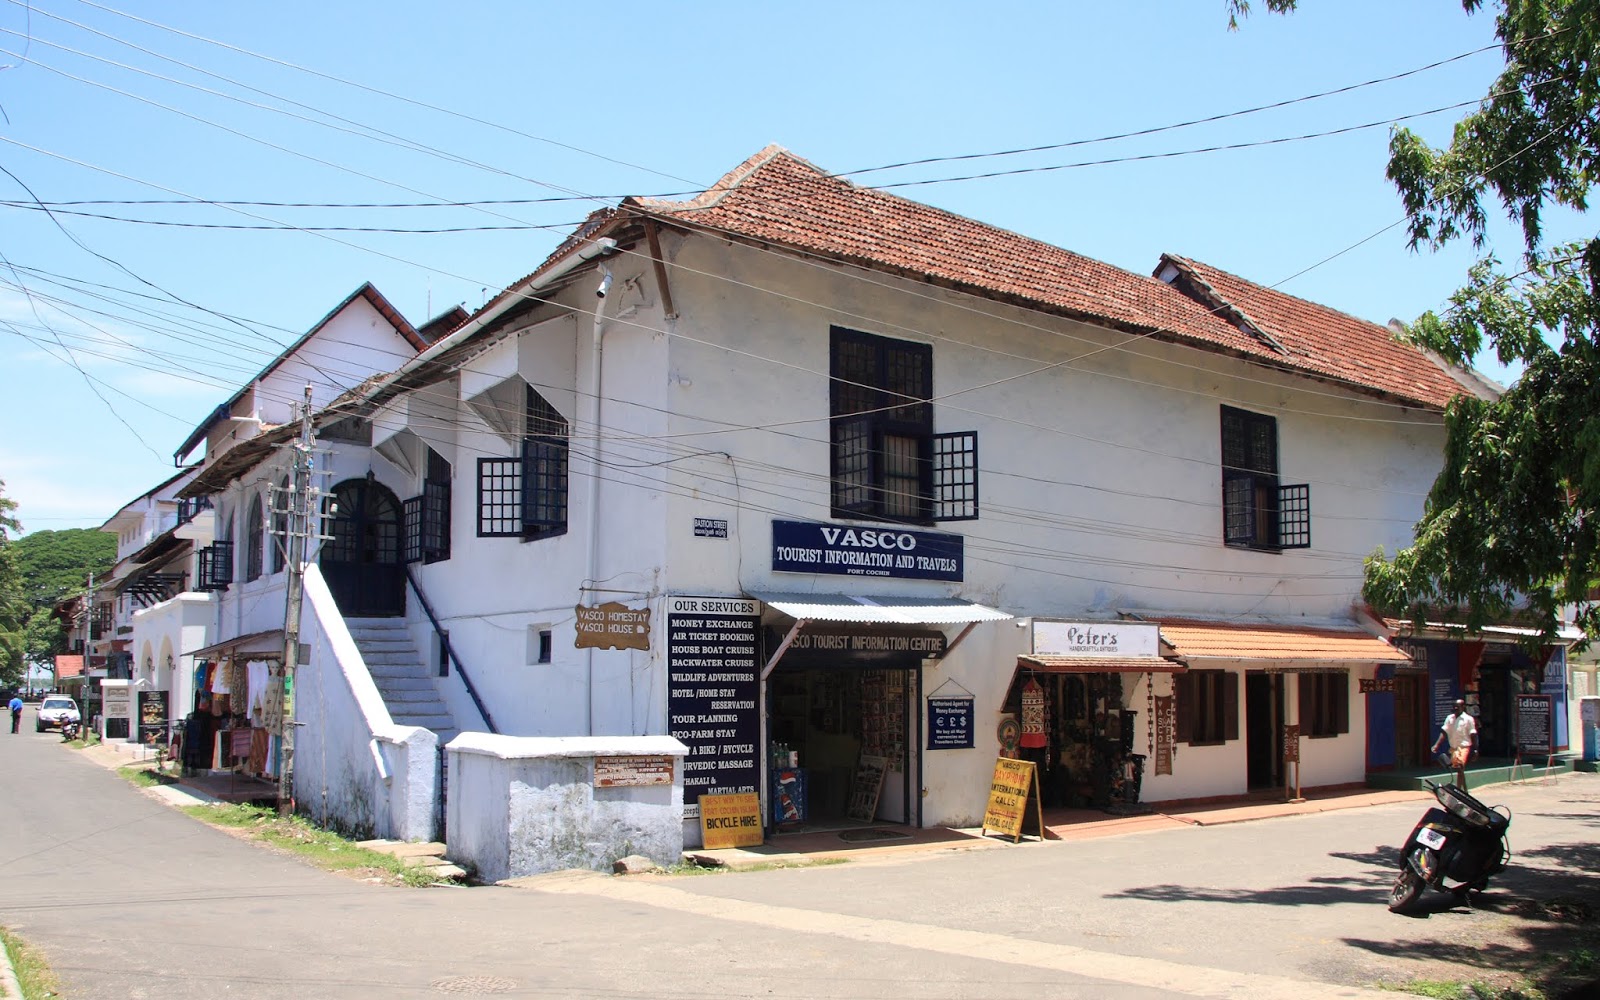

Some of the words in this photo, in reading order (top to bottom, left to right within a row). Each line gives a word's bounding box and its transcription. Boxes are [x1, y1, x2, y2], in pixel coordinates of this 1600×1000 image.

[694, 519, 713, 528] BASTION
[713, 520, 727, 530] STREET
[820, 527, 917, 550] VASCO
[777, 546, 823, 563] TOURIST
[825, 549, 893, 567] INFORMATION
[895, 556, 915, 569] AND
[916, 557, 957, 572] TRAVELS
[674, 600, 698, 611] OUR
[701, 601, 754, 613] SERVICES
[579, 610, 605, 621] VASCO
[608, 612, 647, 622] HOMESTAY
[579, 622, 604, 633] VASCO
[608, 623, 633, 634] HOUSE
[671, 619, 704, 628] MONEY
[706, 620, 754, 629] EXCHANGE
[672, 632, 687, 640] AIR
[688, 633, 718, 641] TICKET
[720, 633, 755, 642] BOOKING
[1067, 625, 1118, 645] Peter's
[813, 635, 849, 649] TOURIST
[851, 635, 909, 650] INFORMATION
[910, 637, 942, 651] CENTRE
[671, 645, 700, 654] HOUSE
[701, 646, 724, 654] BOAT
[725, 646, 754, 655] CRUISE
[671, 659, 723, 667] BACKWATER
[724, 659, 754, 667] CRUISE
[671, 673, 707, 682] WILDLIFE
[707, 673, 754, 682] ADVENTURES
[672, 689, 695, 698] HOTEL
[719, 689, 736, 697] STAY
[711, 700, 755, 710] RESERVATION
[1518, 698, 1549, 708] idiom
[672, 715, 696, 724] TOUR
[697, 714, 738, 723] PLANNING
[936, 716, 945, 727] €
[949, 716, 956, 727] £
[959, 716, 967, 727] $
[672, 730, 714, 739] ECO-FARM
[715, 729, 737, 738] STAY
[692, 746, 698, 755] A
[699, 746, 716, 755] BIKE
[717, 745, 721, 756] /
[723, 744, 754, 754] BYCYCLE
[683, 761, 717, 771] URVEDIC
[718, 760, 754, 769] MASSAGE
[1002, 762, 1021, 771] VASCO
[684, 777, 710, 786] HAKALI
[710, 776, 717, 785] &
[993, 769, 1026, 785] PAYPHONE
[707, 786, 736, 795] MARTIAL
[737, 785, 754, 794] ARTS
[991, 784, 1026, 797] INTERNATIONAL
[995, 796, 1016, 807] CALLS
[706, 816, 738, 829] BICYCLE
[739, 815, 758, 827] HIRE
